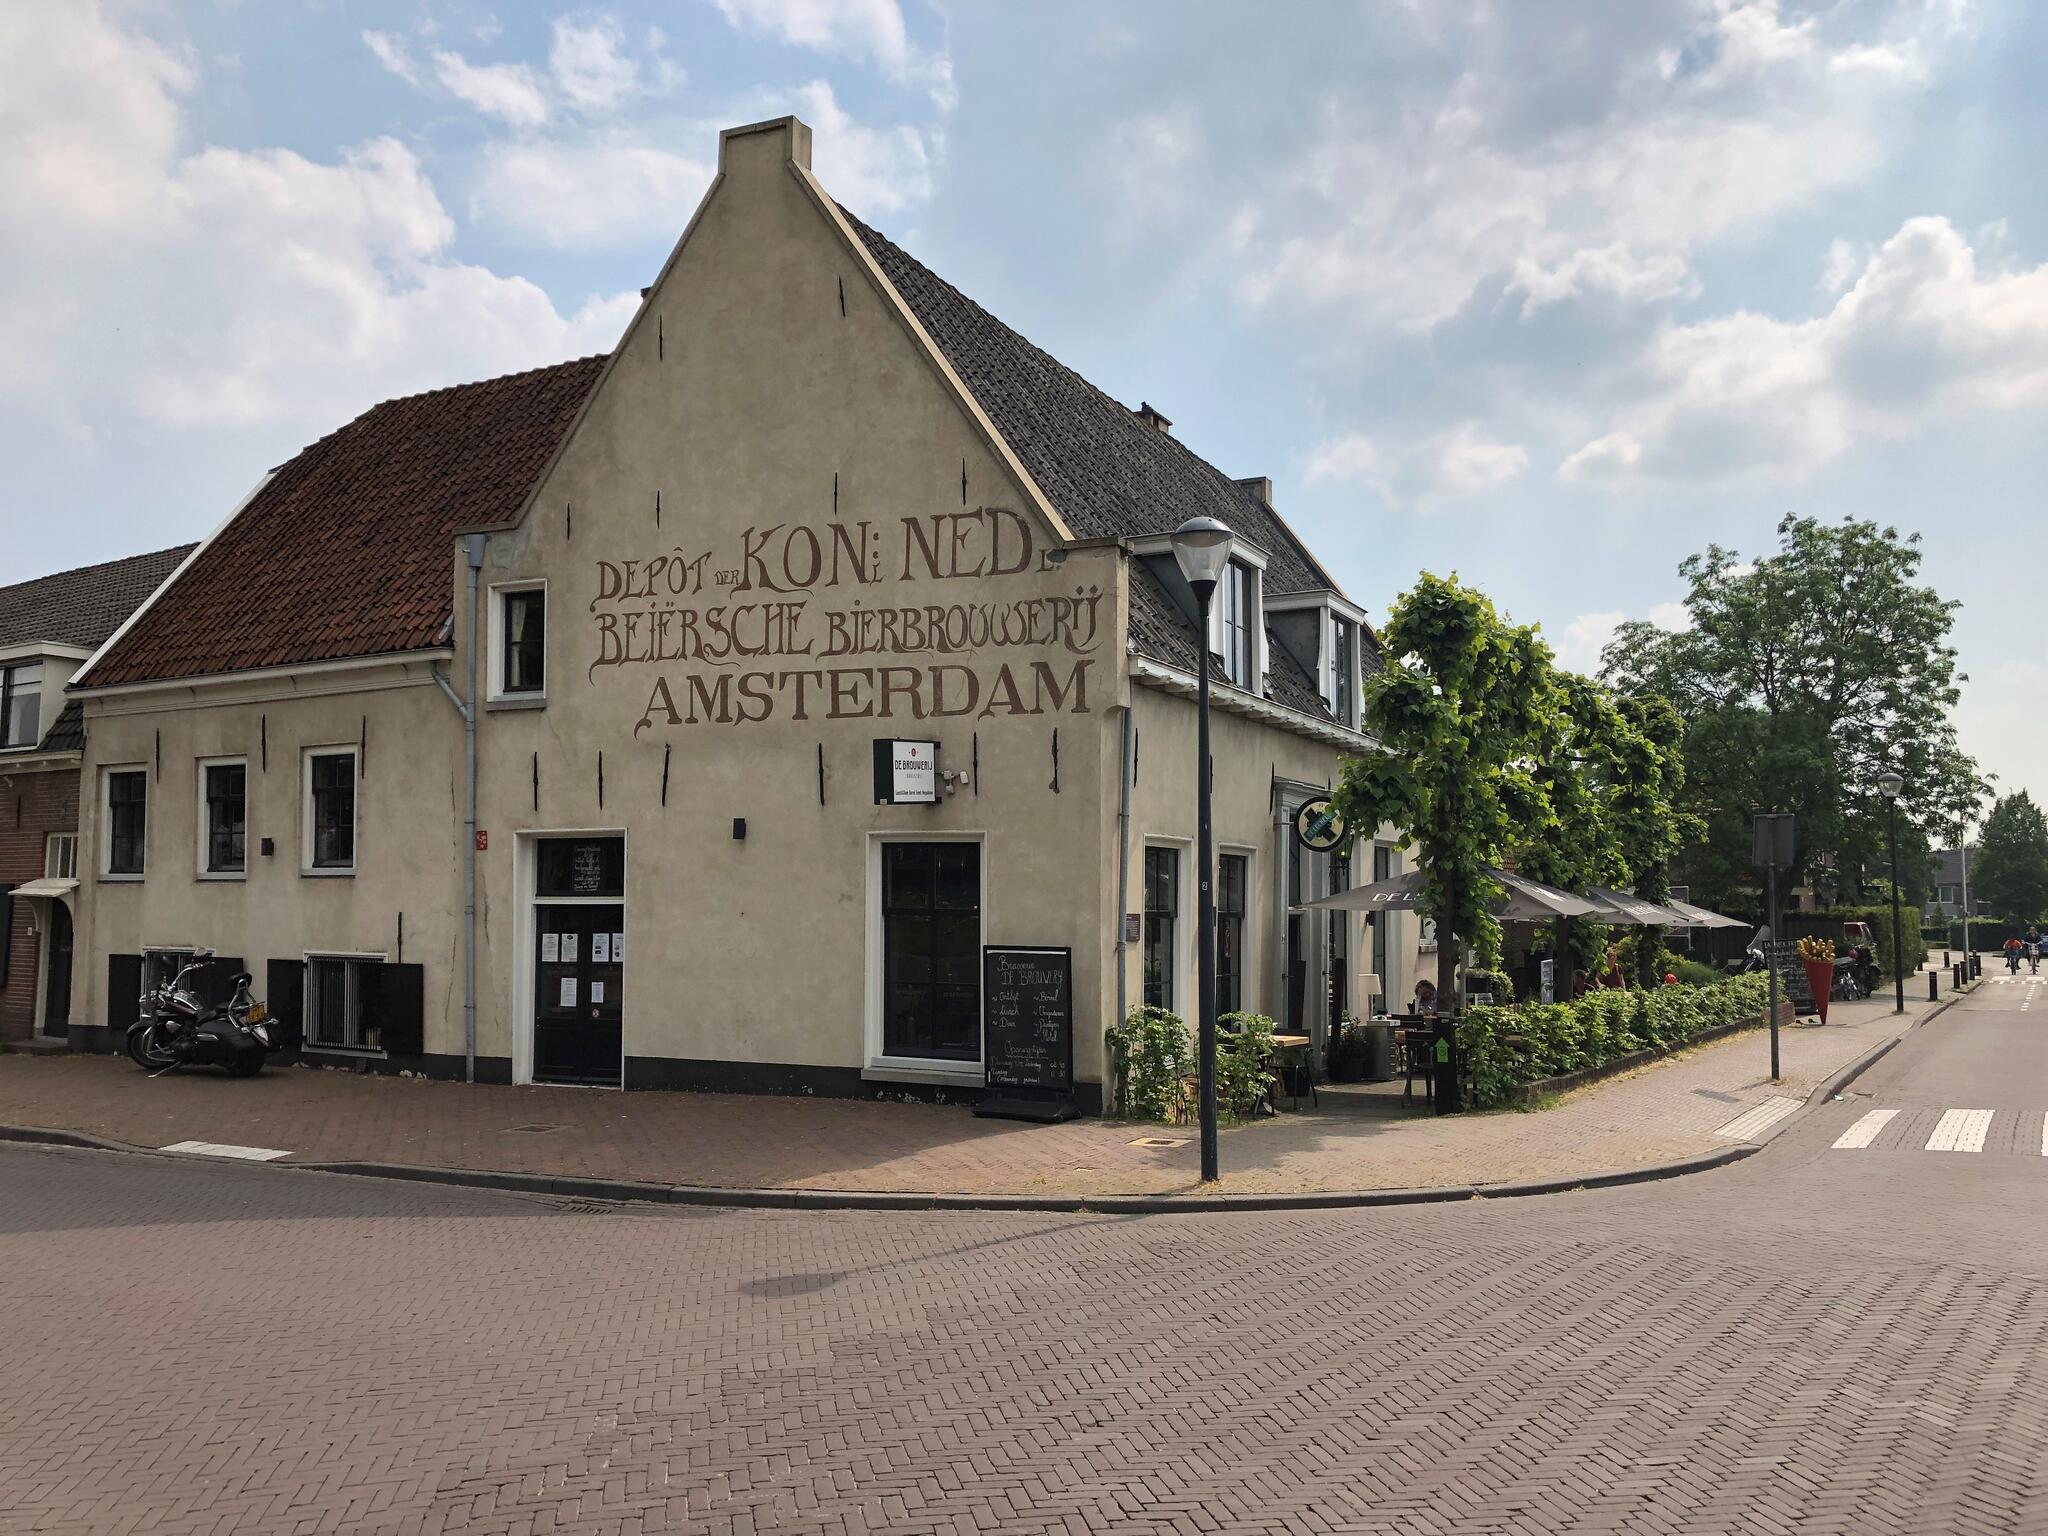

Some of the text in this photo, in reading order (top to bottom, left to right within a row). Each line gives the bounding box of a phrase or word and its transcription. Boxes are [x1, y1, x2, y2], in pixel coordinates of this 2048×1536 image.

[590, 546, 713, 612] DEPÔT
[714, 569, 742, 586] DER
[634, 659, 1096, 740] AMSTERDAM
[895, 760, 932, 770] DE BROUWERIJ
[1372, 892, 1401, 902] DE
